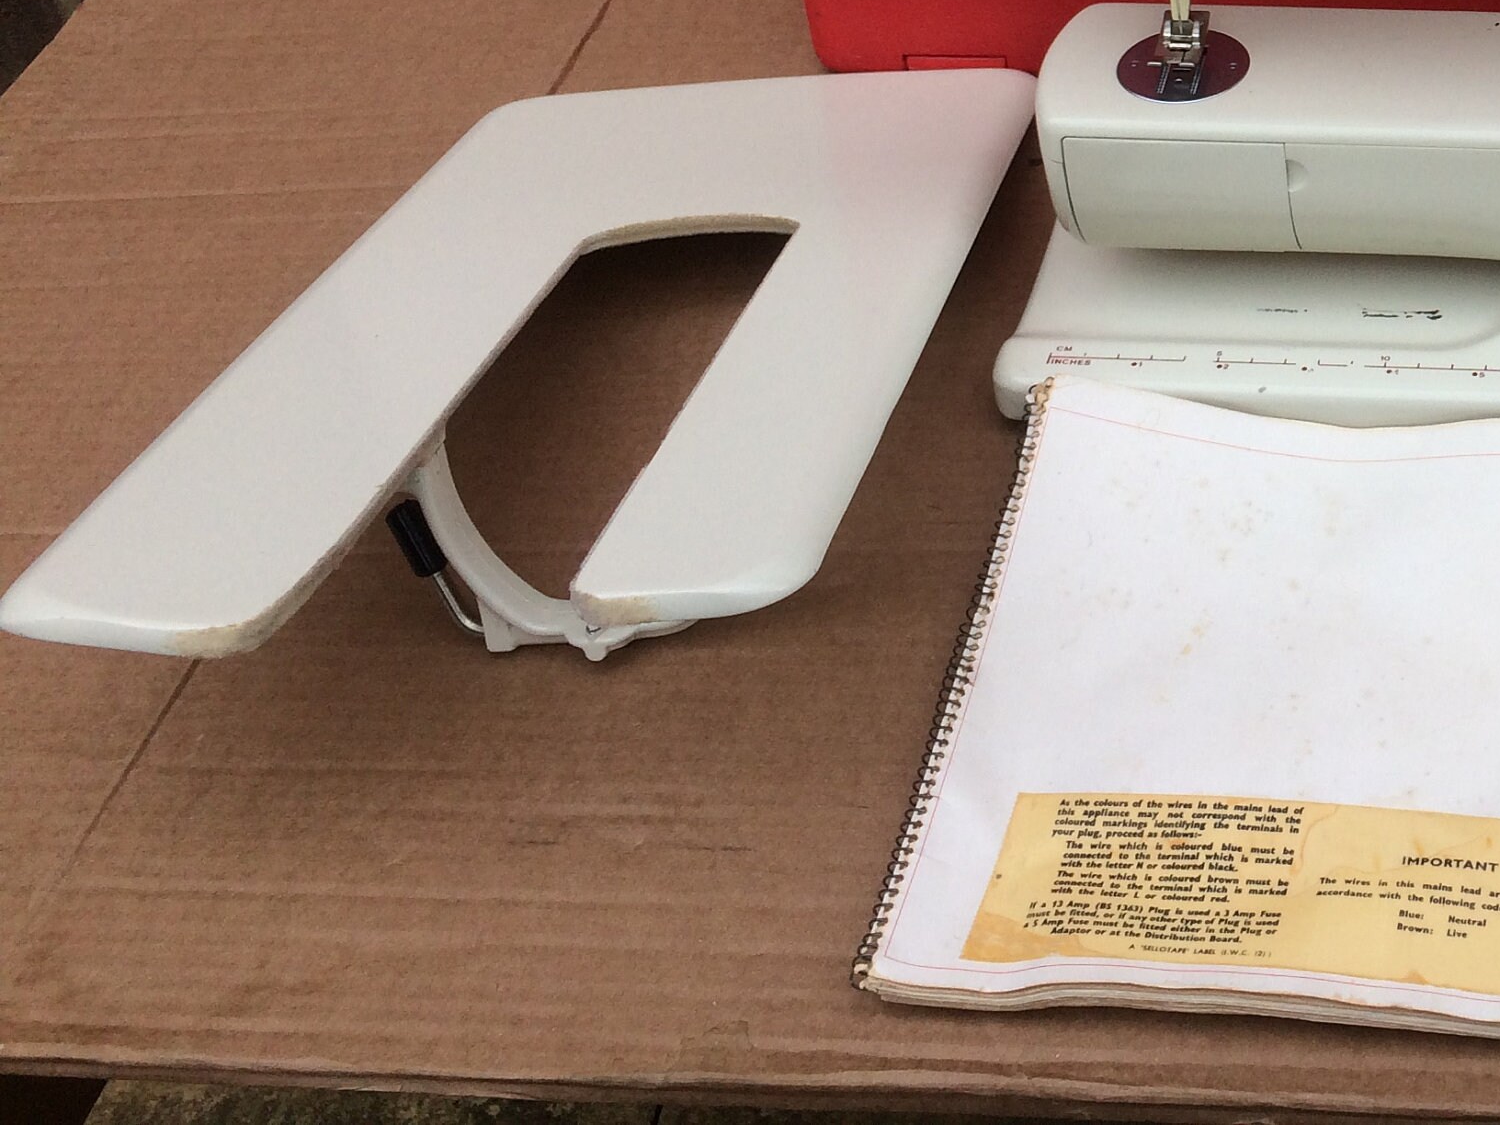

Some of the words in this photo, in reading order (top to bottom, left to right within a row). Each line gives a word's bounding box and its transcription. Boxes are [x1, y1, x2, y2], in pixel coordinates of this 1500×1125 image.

[1094, 799, 1128, 807] colours
[1132, 799, 1142, 807] of
[1147, 800, 1163, 808] the
[1168, 801, 1192, 809] wires
[1198, 801, 1207, 809] in
[1213, 802, 1228, 810] the
[1234, 803, 1262, 812] mains
[1268, 805, 1288, 813] lead
[1294, 807, 1304, 815] of
[1083, 809, 1130, 818] appliance
[1138, 811, 1159, 819] may
[1192, 813, 1246, 821] correspond
[1255, 815, 1276, 823] with
[1286, 816, 1301, 824] the
[1055, 818, 1096, 827] coloured
[1102, 819, 1147, 829] markings
[1154, 821, 1206, 830] identifying
[1237, 823, 1283, 833] terminals
[1052, 829, 1074, 837] your
[1078, 829, 1102, 838] plug,
[1106, 830, 1144, 839] proceed
[1066, 841, 1083, 849] The
[1090, 842, 1111, 850] wire
[1119, 842, 1147, 850] which
[1155, 842, 1163, 850] is
[1222, 843, 1242, 852] blue
[1251, 846, 1275, 854] must
[1283, 847, 1294, 855] be
[1106, 861, 1134, 869] letter
[1205, 853, 1234, 861] which
[1255, 857, 1293, 865] marked
[1402, 856, 1499, 873] IMPORTANT
[1081, 871, 1102, 879] wire
[1109, 873, 1137, 881] which
[1208, 875, 1239, 884] brown
[1278, 878, 1289, 887] be
[1344, 878, 1370, 886] wires
[1423, 883, 1452, 892] mains
[1461, 886, 1481, 895] lead
[1150, 884, 1192, 892] terminal
[1199, 885, 1227, 893] which
[1162, 893, 1205, 901] coloured
[1316, 889, 1372, 898] accordance
[1379, 892, 1400, 900] with
[1408, 894, 1423, 903] the
[1430, 895, 1475, 909] following
[1029, 901, 1037, 909] If
[1067, 901, 1090, 909] Amp
[1095, 902, 1111, 910] (BS
[1117, 904, 1143, 913] 1363)
[1148, 907, 1170, 915] Plug
[1233, 910, 1255, 918] Amp
[1070, 909, 1099, 917] fitted,
[1129, 914, 1147, 922] any
[1181, 917, 1202, 925] type
[1218, 918, 1240, 927] Plug
[1399, 910, 1424, 920] Blue:
[1448, 915, 1486, 927] Neutral
[1032, 919, 1038, 927] 5
[1139, 923, 1166, 931] fitted
[1171, 924, 1201, 933] either
[1240, 927, 1262, 936] Plug
[1050, 927, 1092, 935] Adaptor
[1145, 932, 1205, 942] Distribution
[1397, 923, 1433, 934] Brown:
[1447, 929, 1467, 938] Live
